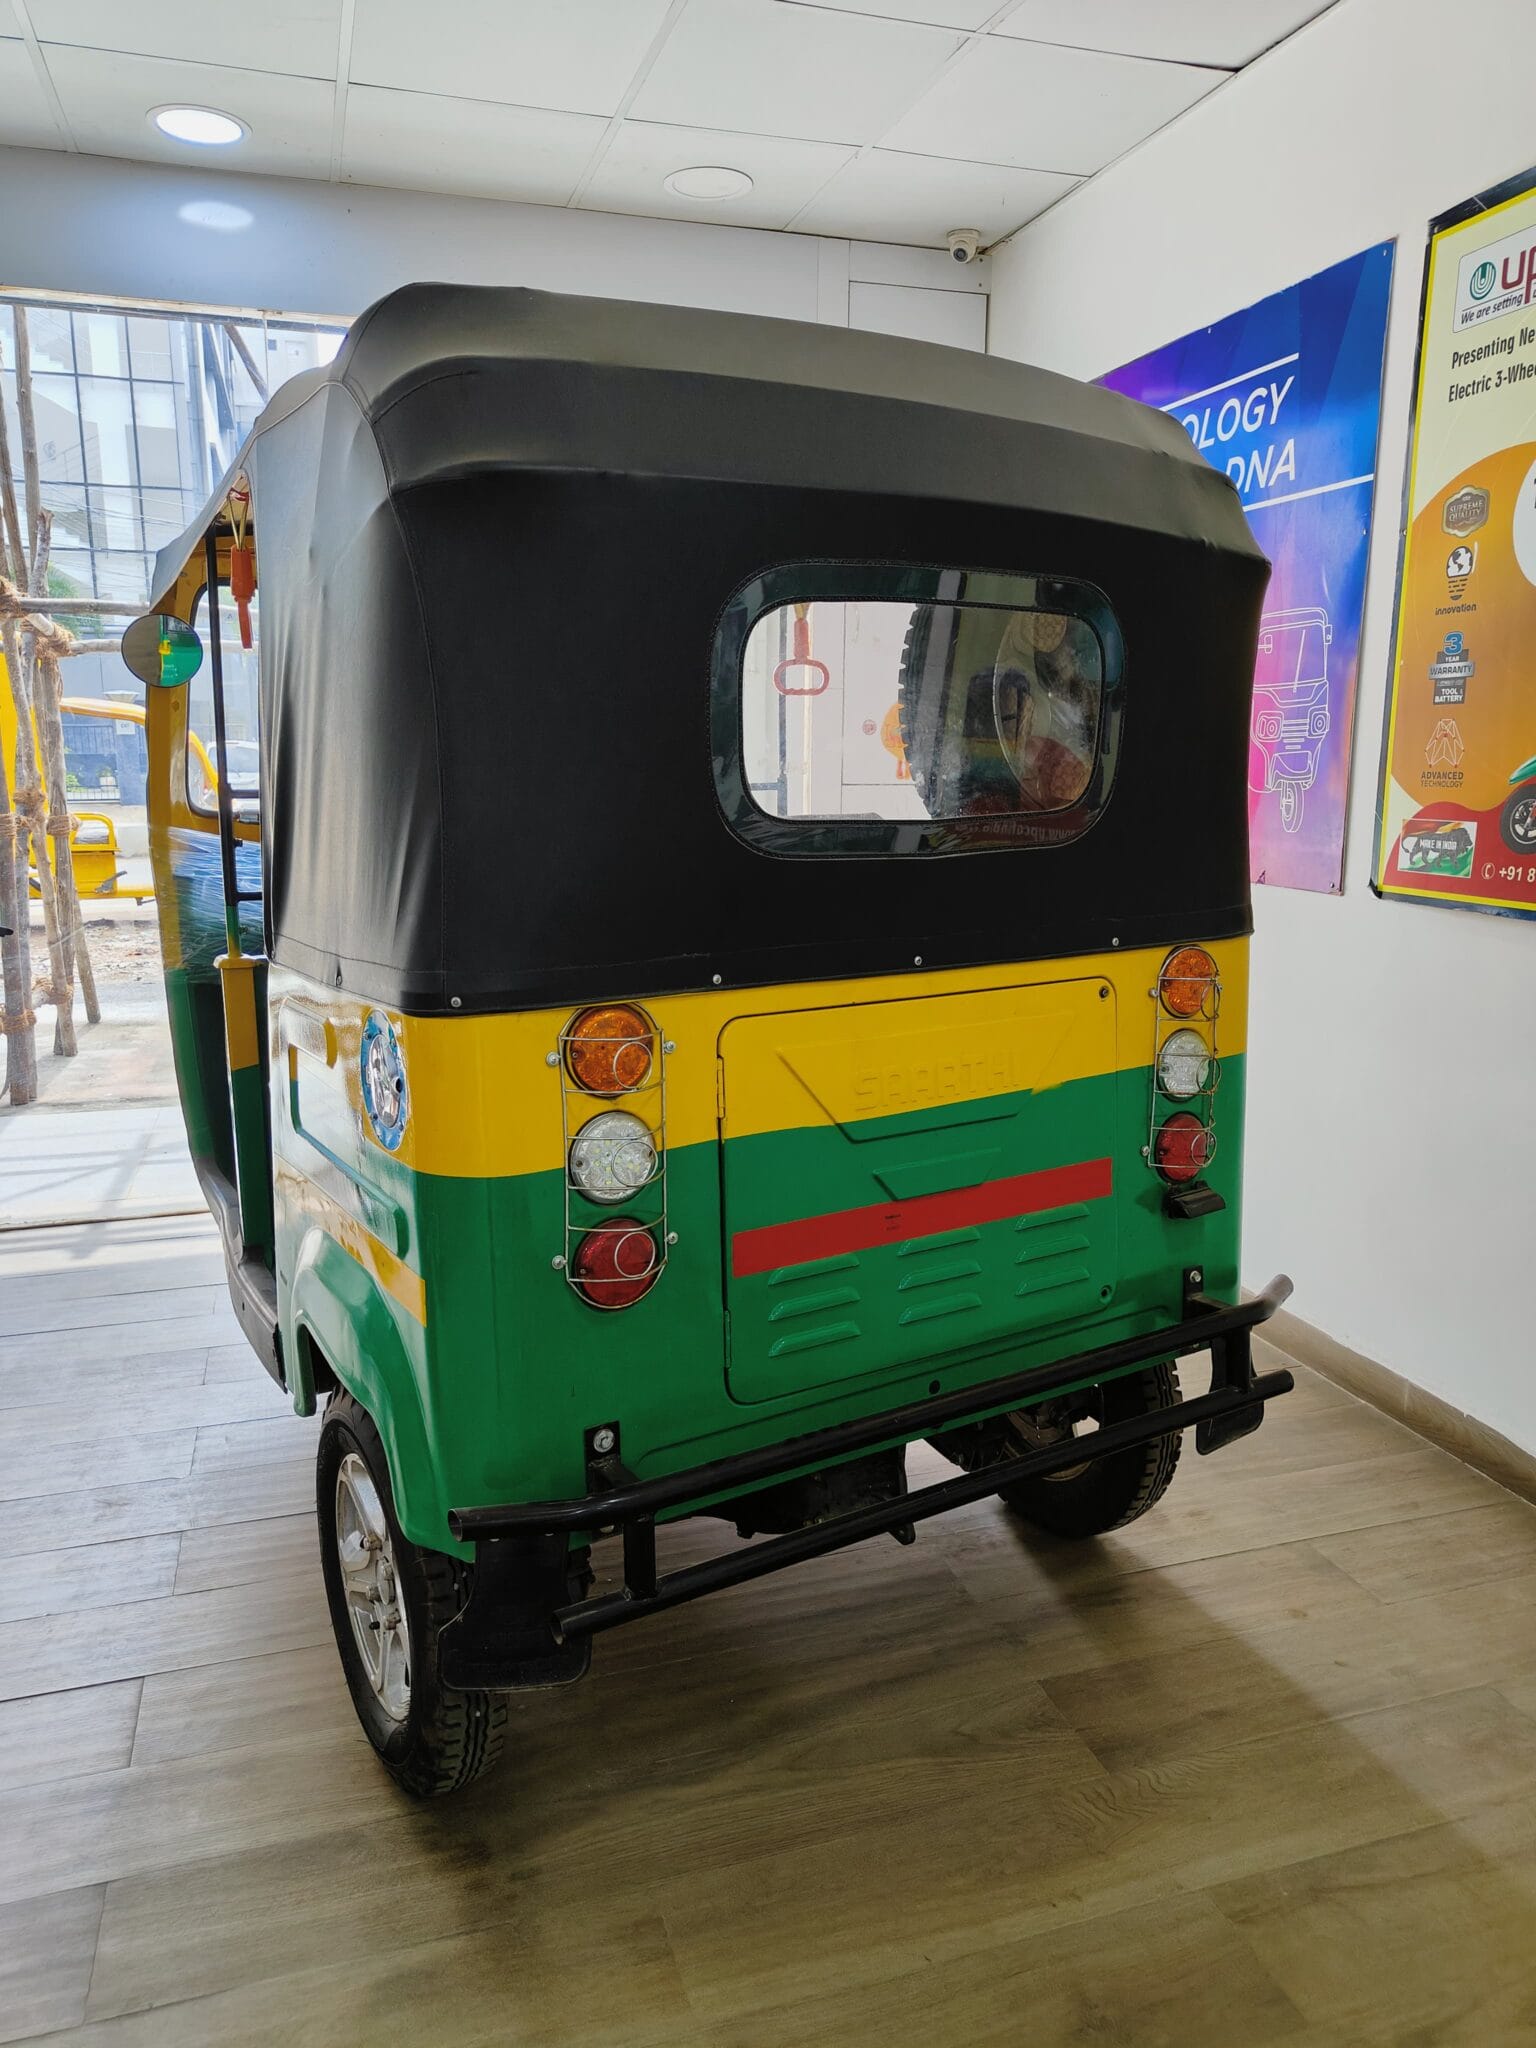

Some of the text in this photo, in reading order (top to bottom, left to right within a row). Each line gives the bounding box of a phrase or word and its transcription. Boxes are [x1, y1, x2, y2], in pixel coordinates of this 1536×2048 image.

[1461, 310, 1474, 325] We
[1476, 304, 1491, 320] are
[1492, 293, 1523, 312] setting
[1451, 334, 1514, 370] Presenting
[1447, 362, 1536, 403] Electric 3-Whe
[1450, 500, 1483, 513] SUPREME
[1449, 509, 1480, 522] QUALITY
[1435, 603, 1477, 615] innovation
[1444, 631, 1463, 655] 3
[1430, 664, 1472, 675] WARRANTY
[1434, 694, 1463, 703] BATTERY
[1421, 771, 1464, 779] ADVANCED
[1421, 780, 1464, 788] TECHNOLOGY
[1419, 839, 1435, 848] MAKE
[1442, 841, 1457, 850] INDIA
[1499, 866, 1523, 881] +91
